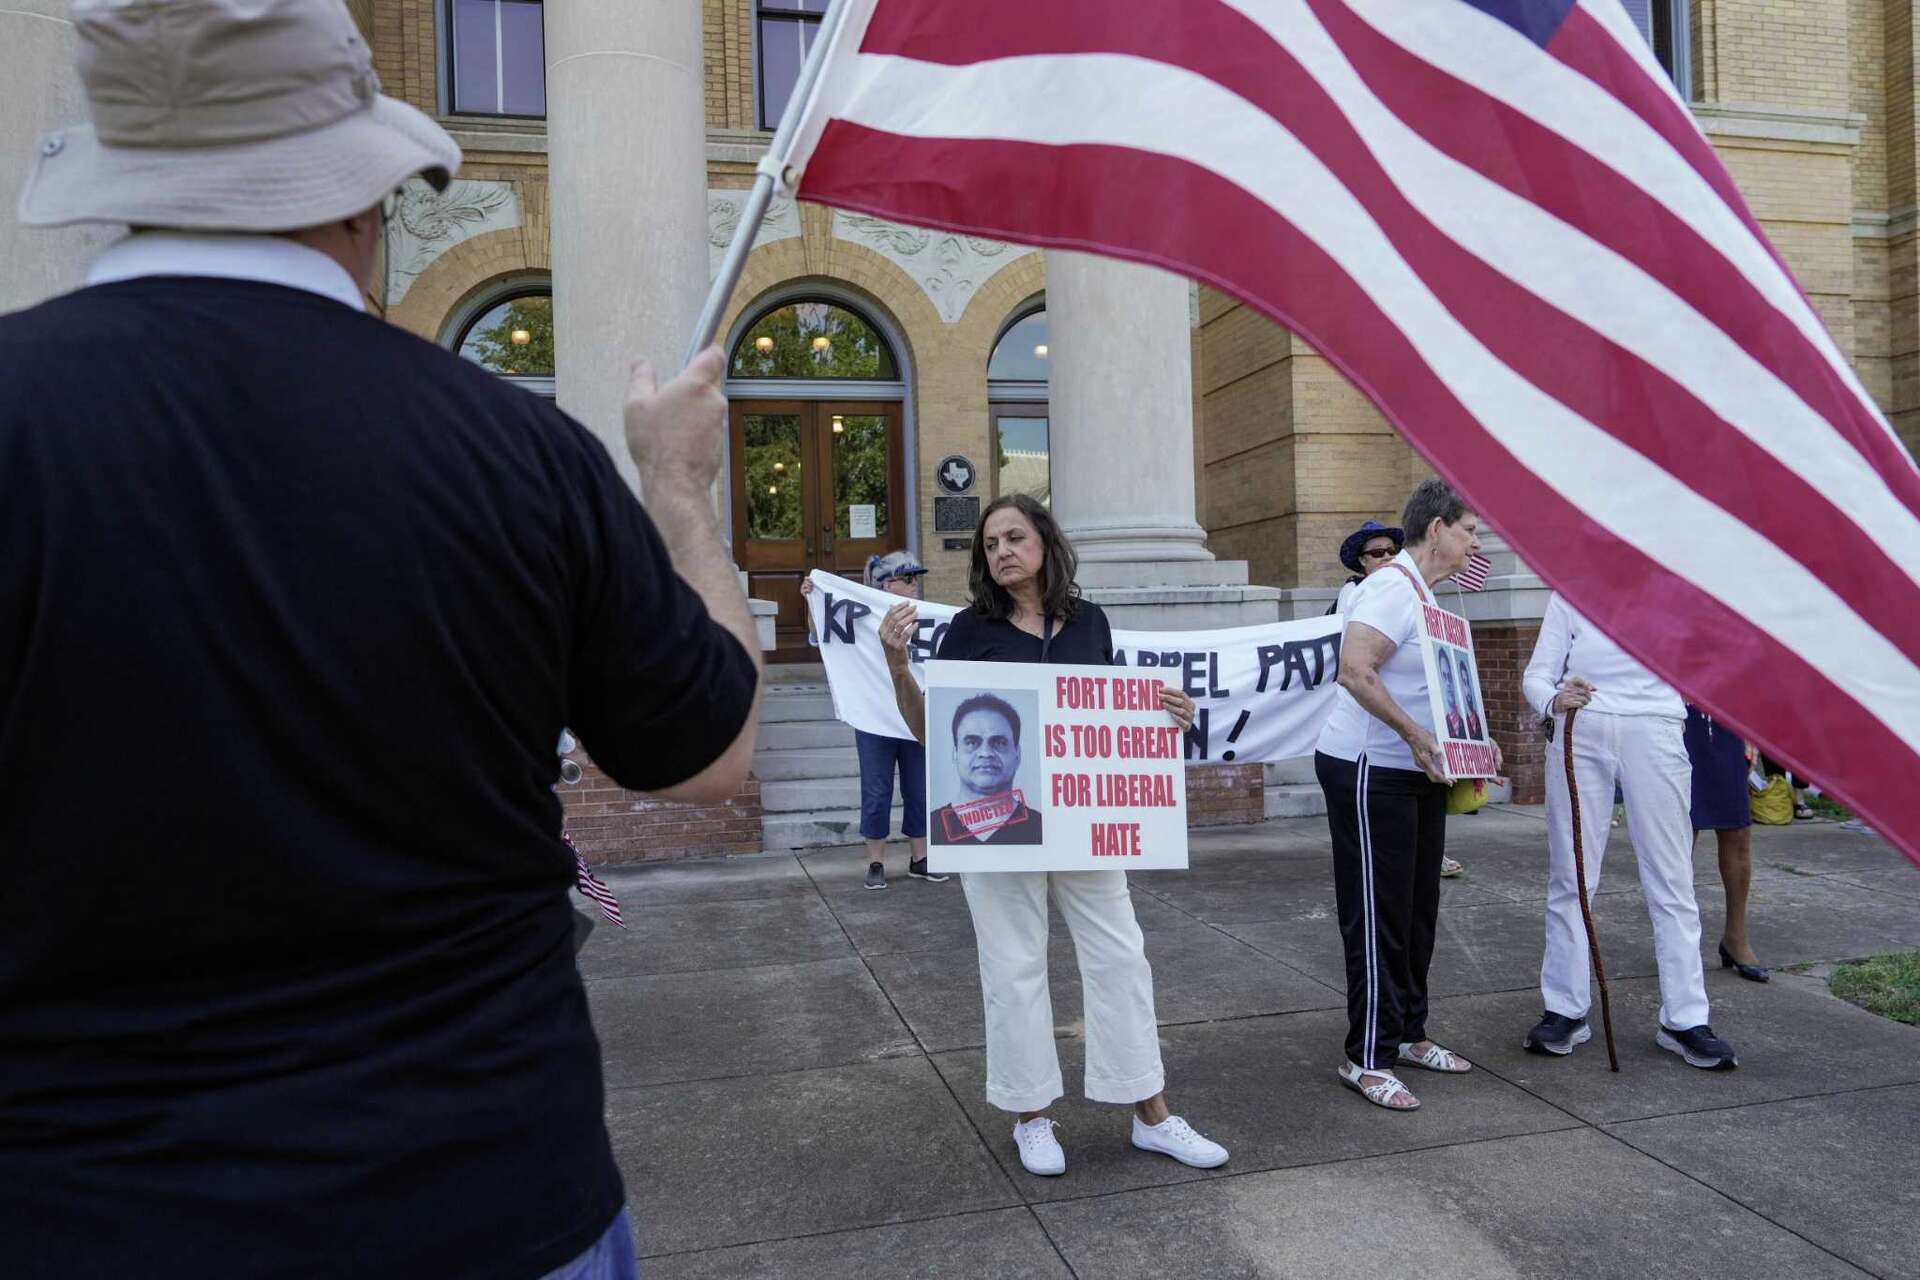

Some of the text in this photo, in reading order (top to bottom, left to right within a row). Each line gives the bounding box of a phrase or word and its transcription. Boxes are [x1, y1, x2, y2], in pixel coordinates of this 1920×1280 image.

[1056, 676, 1165, 711] FORT BEND
[1044, 724, 1179, 759] IS TOO GREAT
[1051, 773, 1177, 808] FOR LIBERAL
[1091, 823, 1141, 856] HATE
